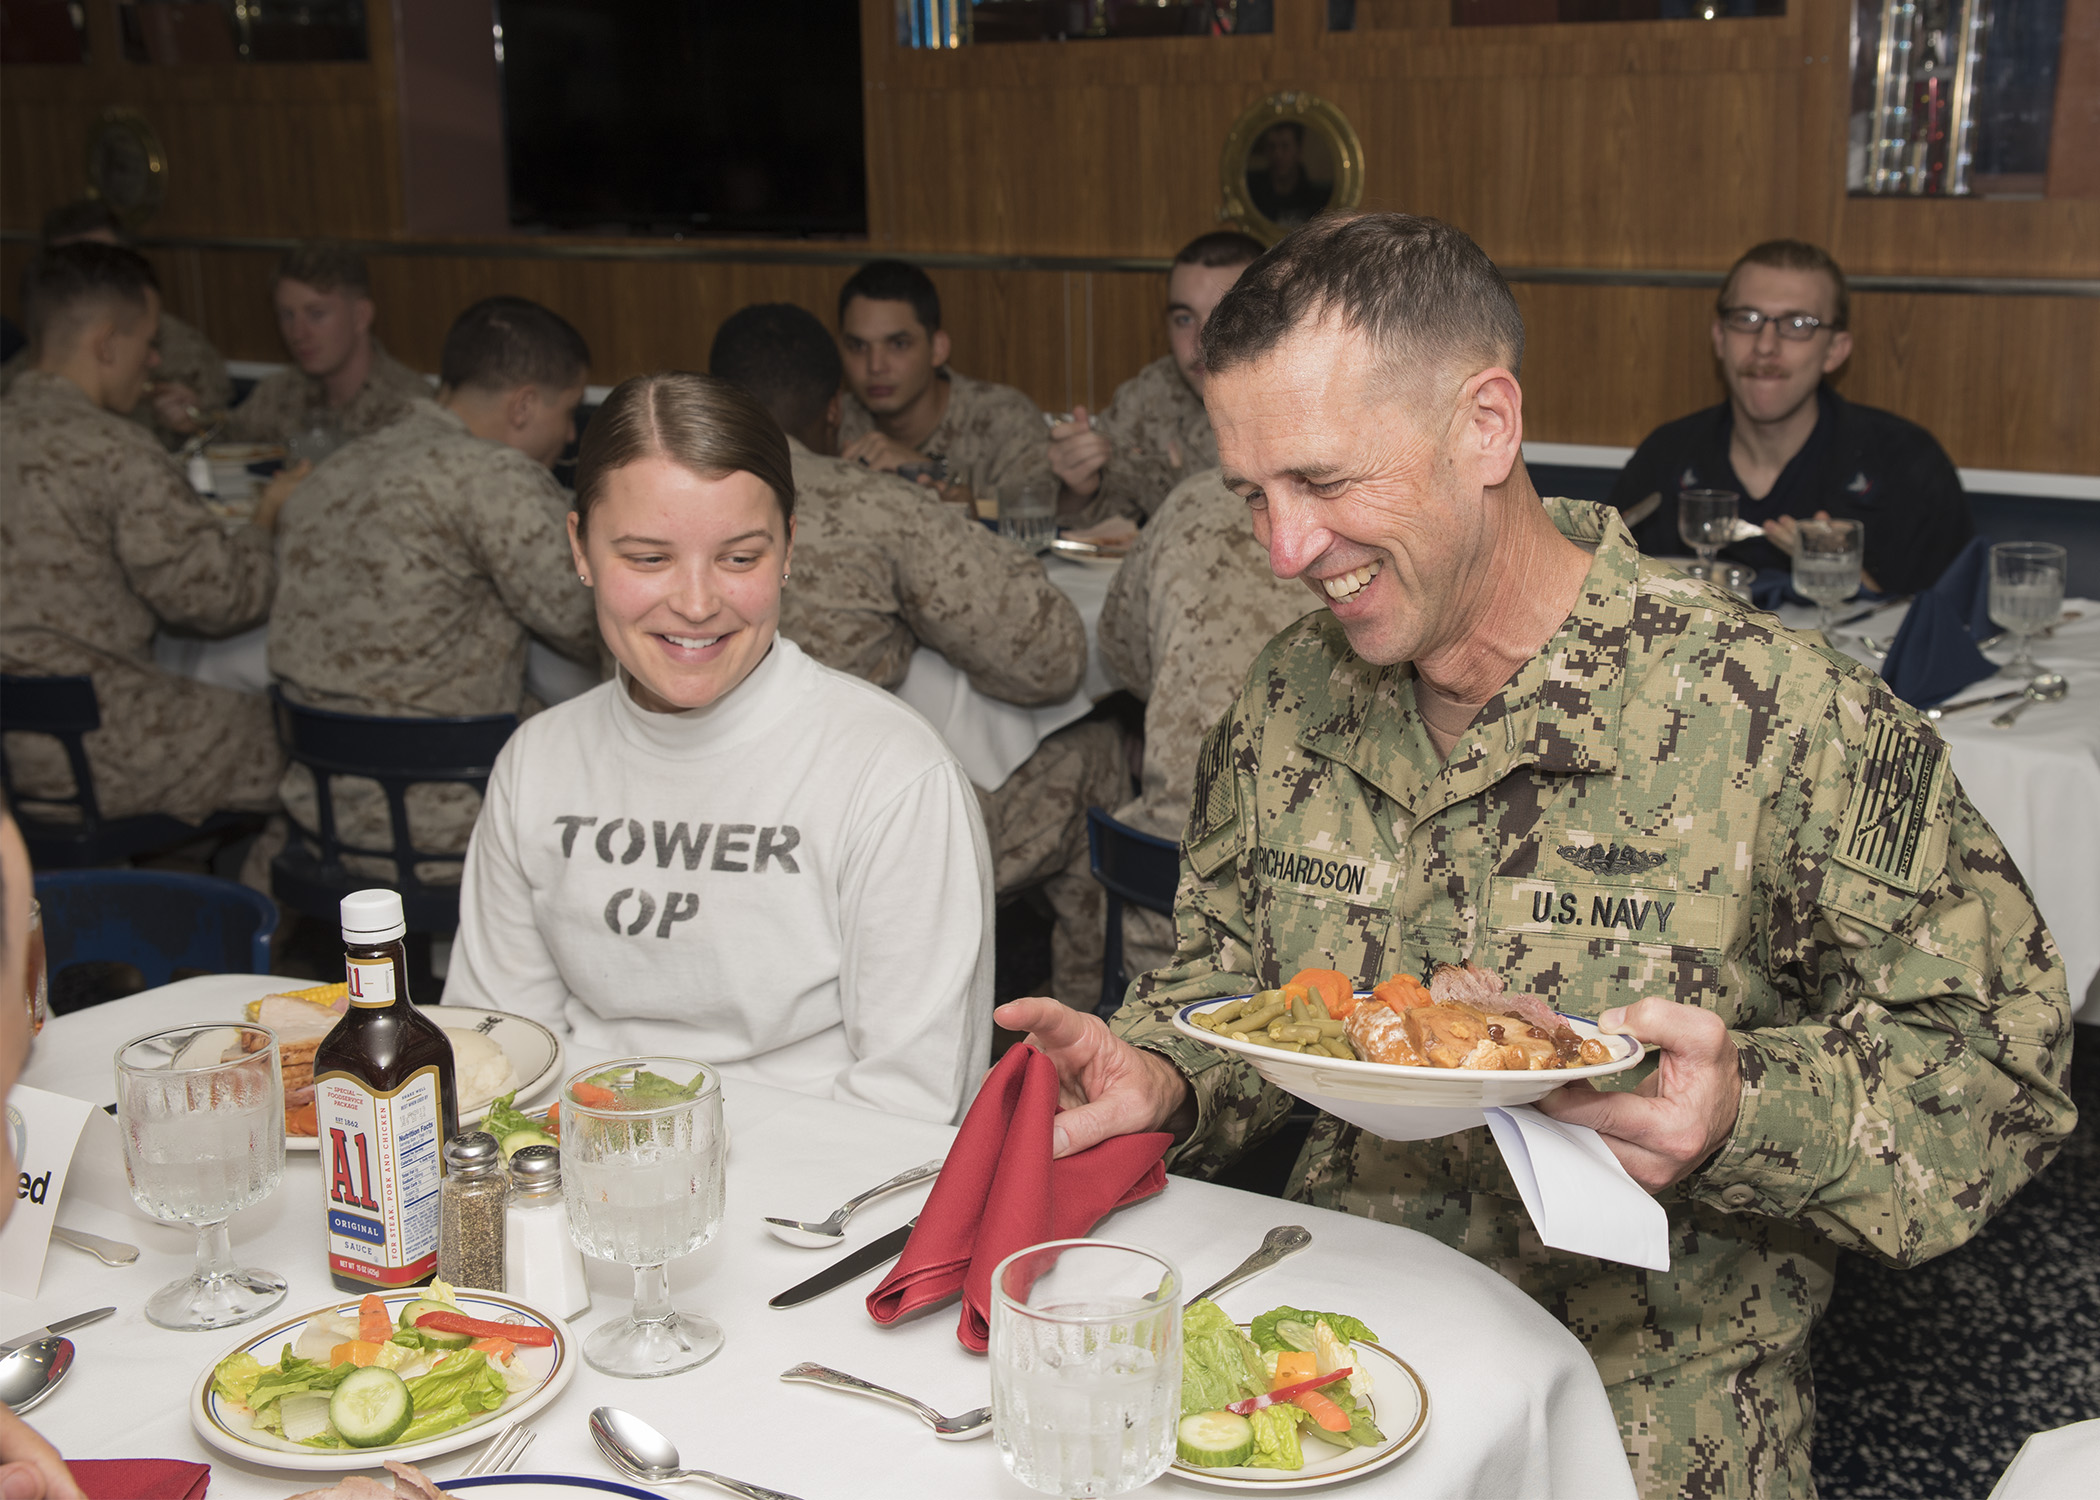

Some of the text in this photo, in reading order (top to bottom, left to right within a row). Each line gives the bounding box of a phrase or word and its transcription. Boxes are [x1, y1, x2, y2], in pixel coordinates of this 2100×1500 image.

[1786, 680, 1804, 689] USN
[1901, 833, 1914, 872] DON'T
[1912, 791, 1925, 830] TREAD
[1921, 772, 1929, 790] ON
[553, 815, 801, 874] TOWER
[1259, 845, 1365, 895] RICHARDSON
[604, 887, 700, 939] OP
[1532, 890, 1675, 933] U.S. NAVY
[328, 1092, 363, 1104] FOODSERVICE
[334, 1086, 355, 1096] SPECIAL
[334, 1100, 358, 1110] PACKAGE
[344, 1119, 358, 1128] 1862
[380, 1107, 389, 1149] CHICKEN
[399, 1128, 420, 1142] Nutrition
[420, 1122, 433, 1132] Facts
[383, 1154, 391, 1173] AND
[385, 1177, 393, 1201] PORK
[334, 1218, 379, 1236] ORIGINAL
[344, 1241, 372, 1255] SAUCE
[339, 1259, 348, 1268] NET
